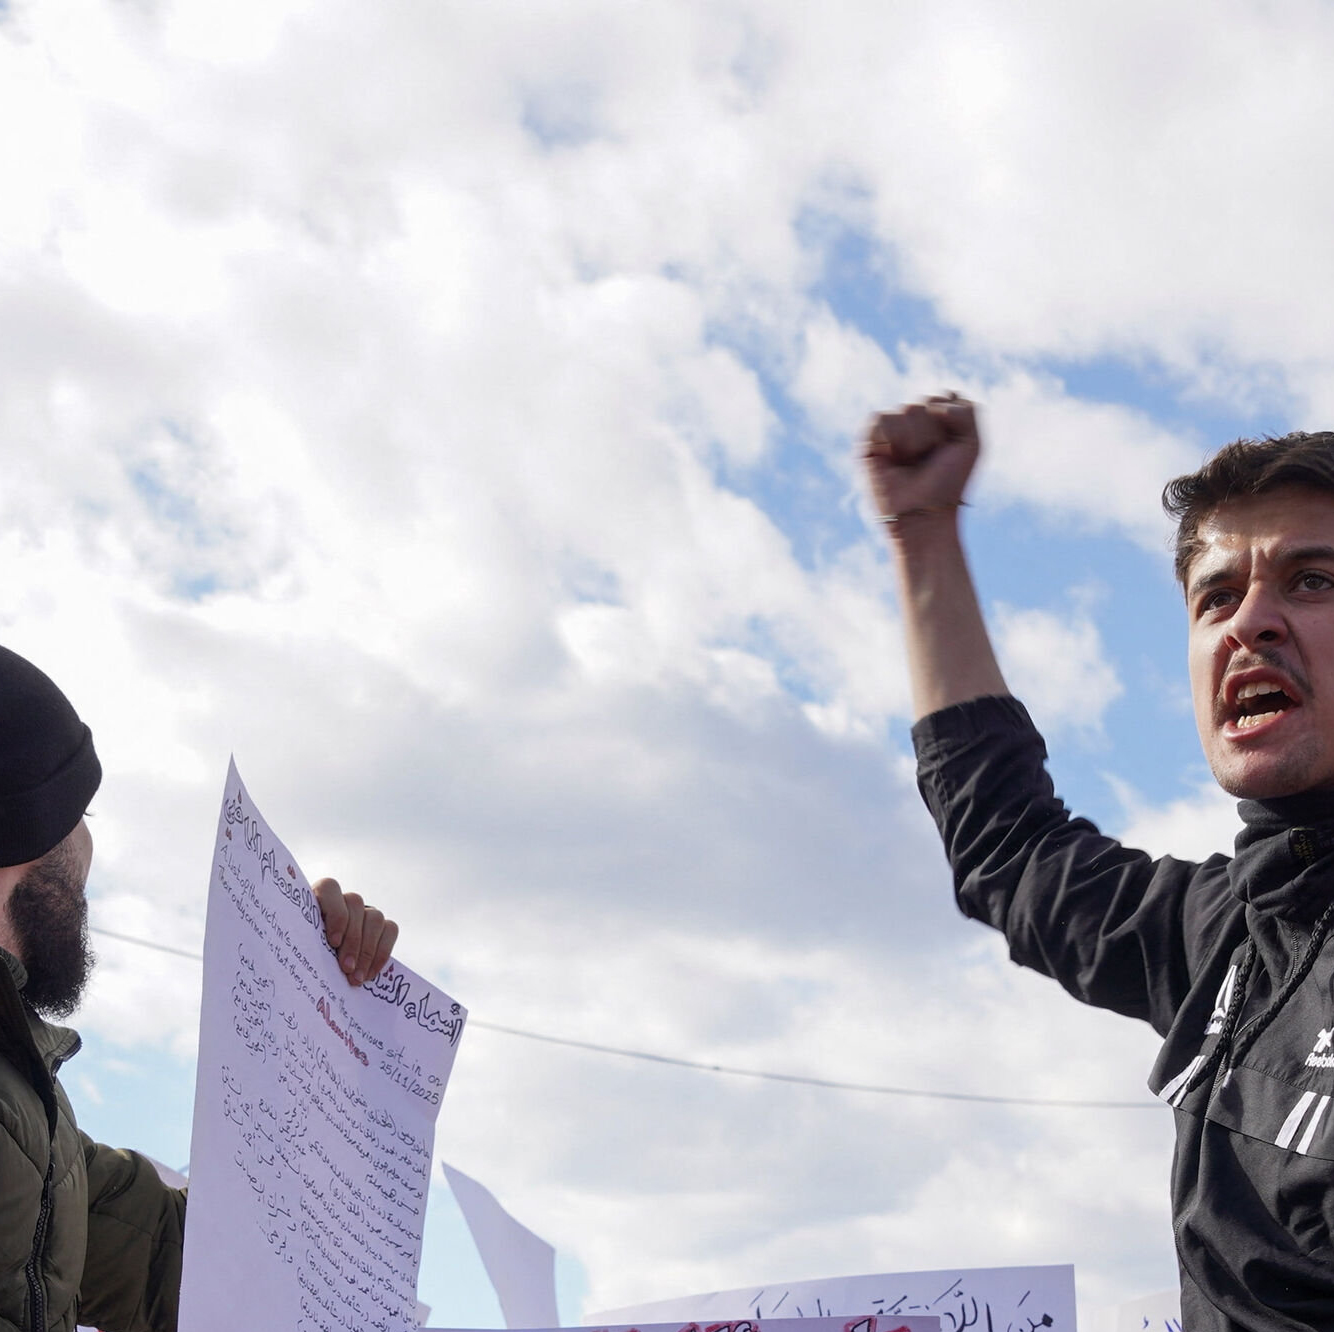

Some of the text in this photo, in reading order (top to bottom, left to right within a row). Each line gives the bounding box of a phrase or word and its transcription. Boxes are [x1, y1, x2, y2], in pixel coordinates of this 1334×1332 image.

[292, 945, 319, 979] names
[348, 1017, 384, 1050] previous
[380, 1061, 440, 1105] 25/11/2025
